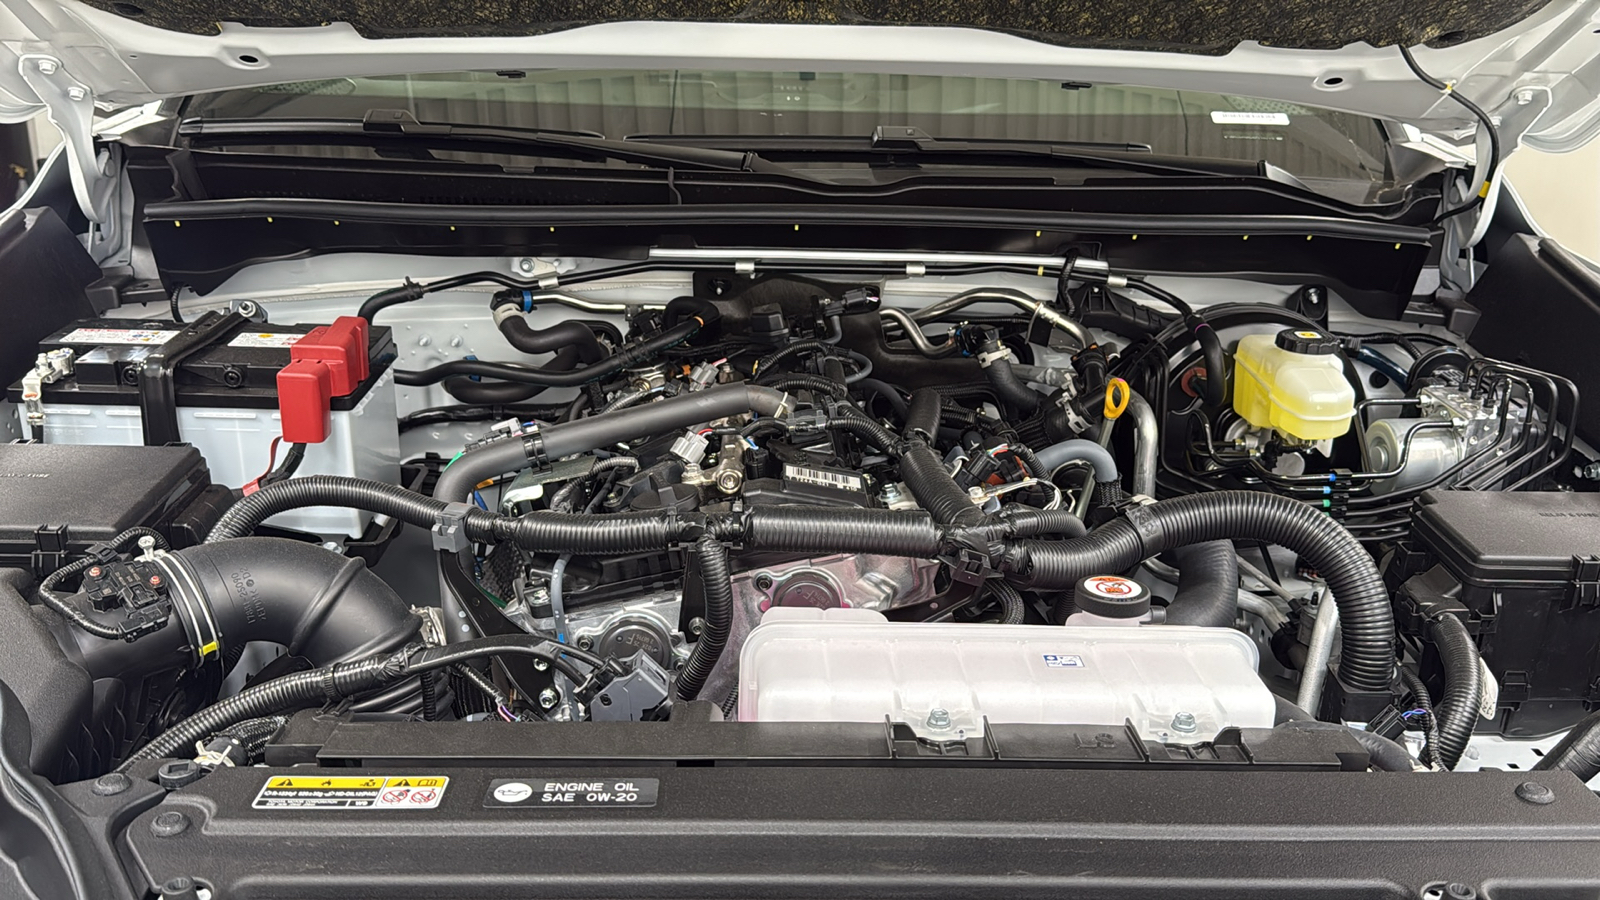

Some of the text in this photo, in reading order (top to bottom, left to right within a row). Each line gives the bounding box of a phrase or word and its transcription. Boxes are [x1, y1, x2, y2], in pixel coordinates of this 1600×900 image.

[544, 783, 640, 792] ENGINE OIL
[541, 793, 638, 802] SAE 0W-20
